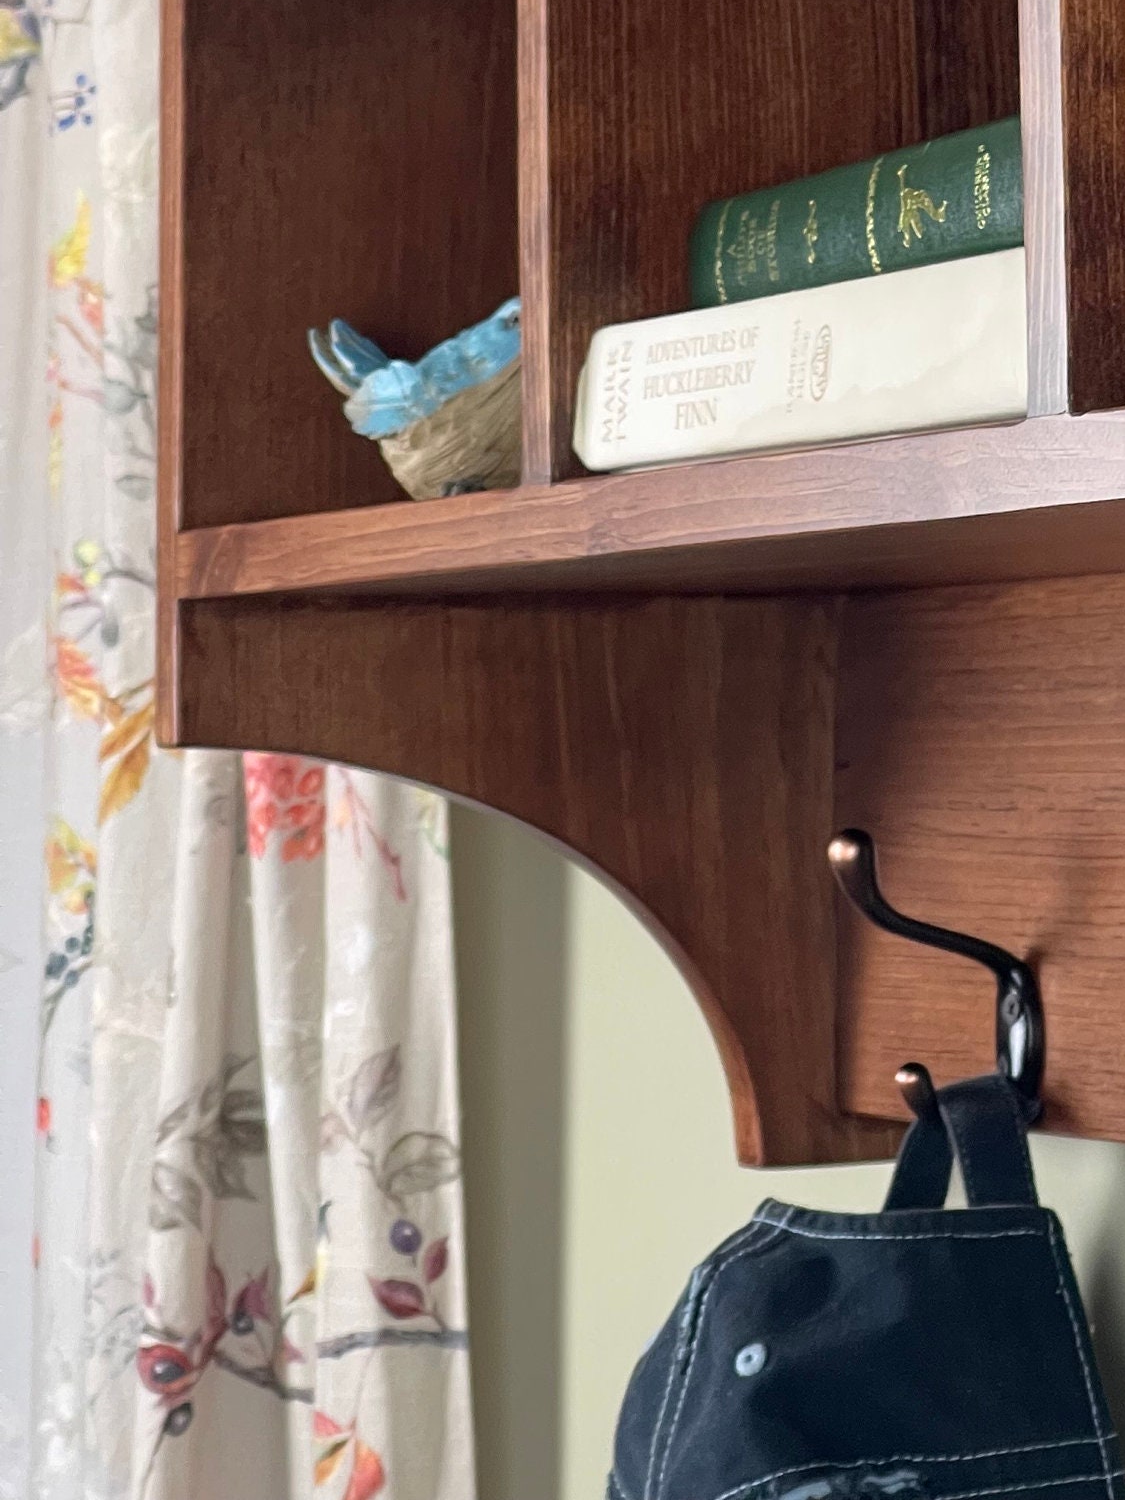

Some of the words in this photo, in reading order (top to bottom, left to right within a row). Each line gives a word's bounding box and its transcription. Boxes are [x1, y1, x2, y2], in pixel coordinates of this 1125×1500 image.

[645, 328, 736, 364] ADVENTURES
[740, 324, 760, 350] OF
[642, 358, 757, 400] HUCKLEBERRY
[673, 397, 718, 430] FINN
